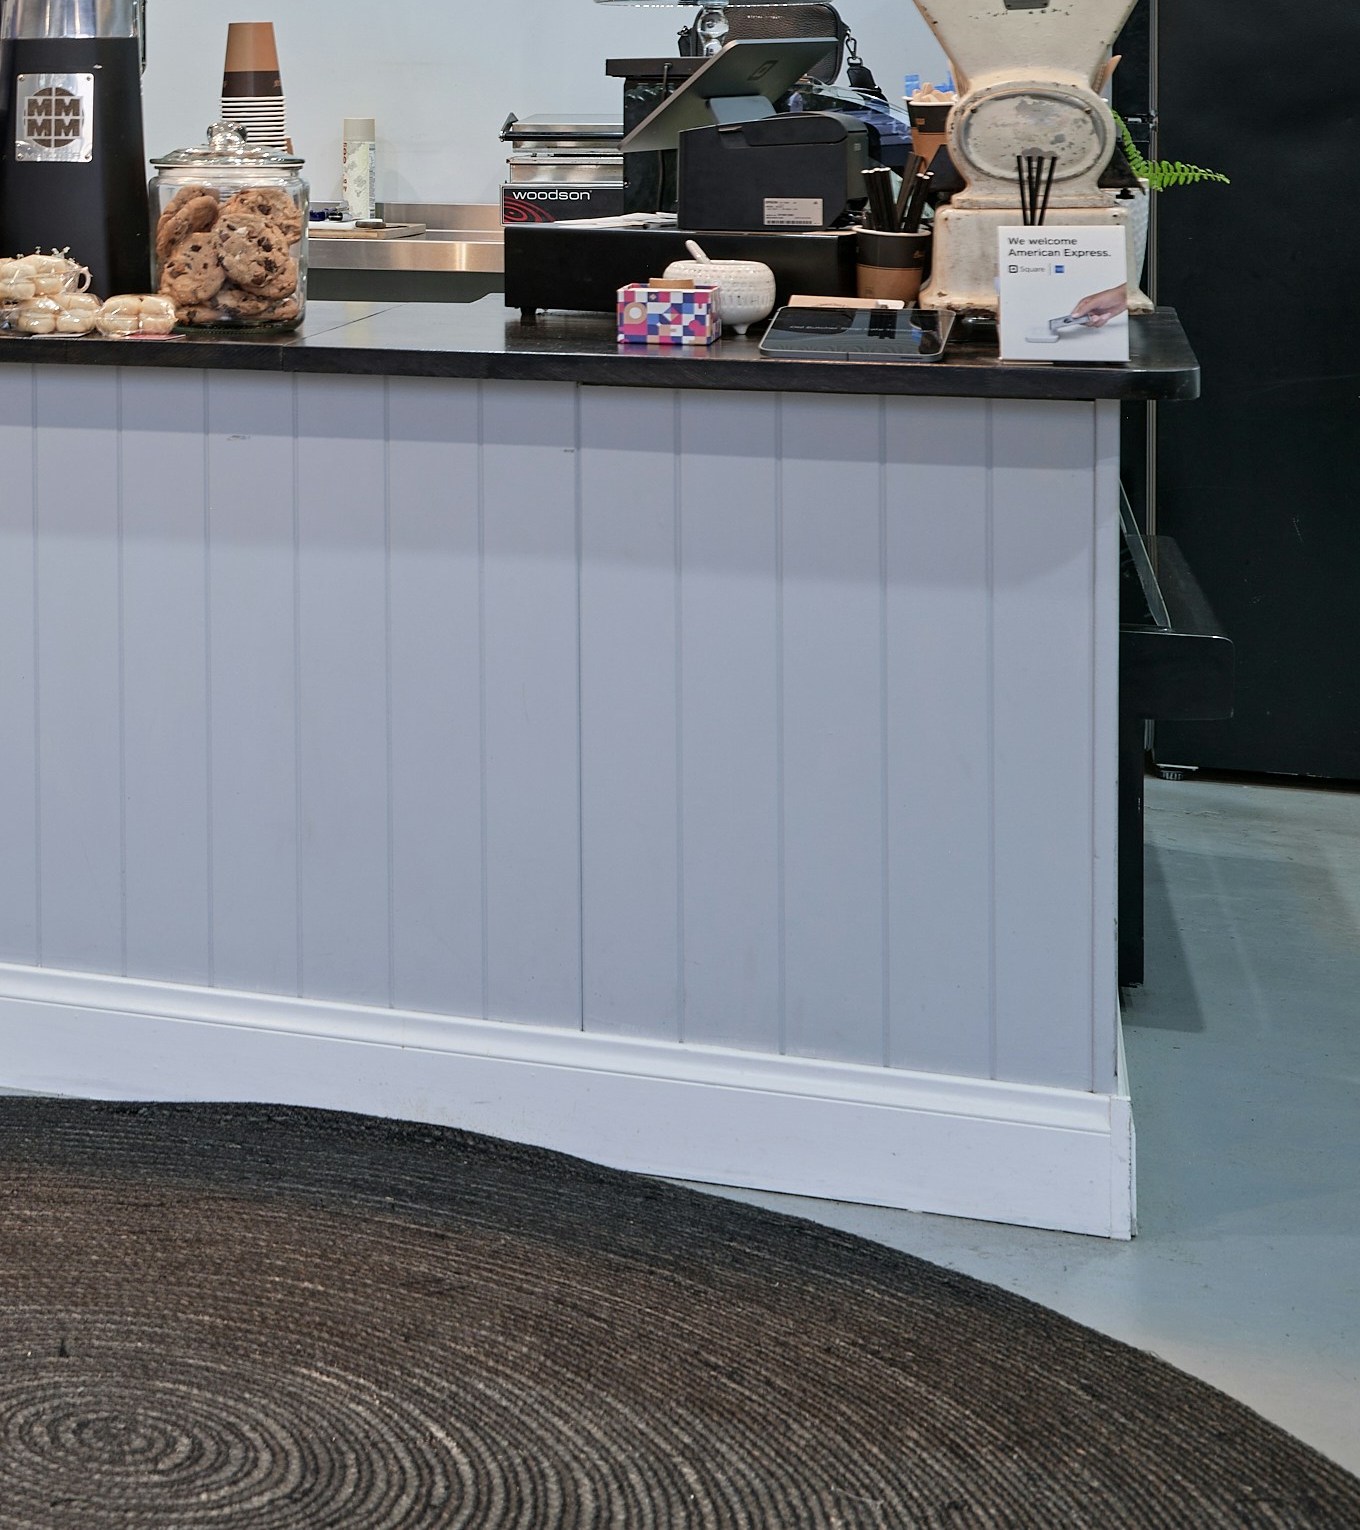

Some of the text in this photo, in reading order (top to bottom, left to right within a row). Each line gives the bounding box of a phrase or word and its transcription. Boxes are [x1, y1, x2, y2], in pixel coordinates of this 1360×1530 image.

[512, 190, 590, 200] woodson
[1008, 237, 1077, 245] We welcome
[1008, 249, 1111, 258] American Express.
